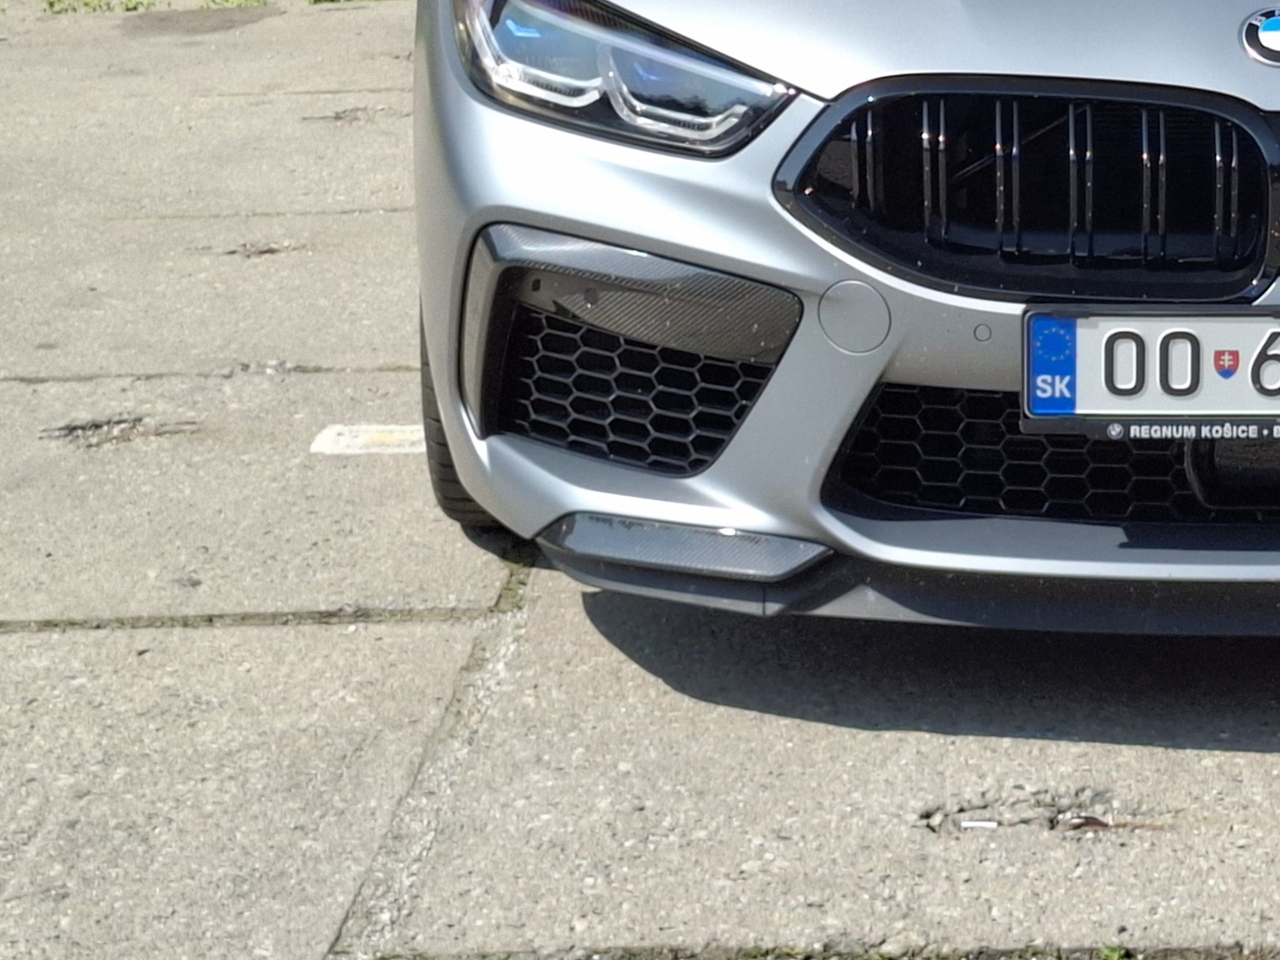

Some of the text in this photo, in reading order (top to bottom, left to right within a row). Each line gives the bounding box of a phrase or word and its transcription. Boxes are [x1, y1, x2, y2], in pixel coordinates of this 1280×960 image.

[1034, 374, 1073, 400] SK
[1128, 424, 1198, 440] REGNUM
[1200, 422, 1260, 440] KOŠICE
